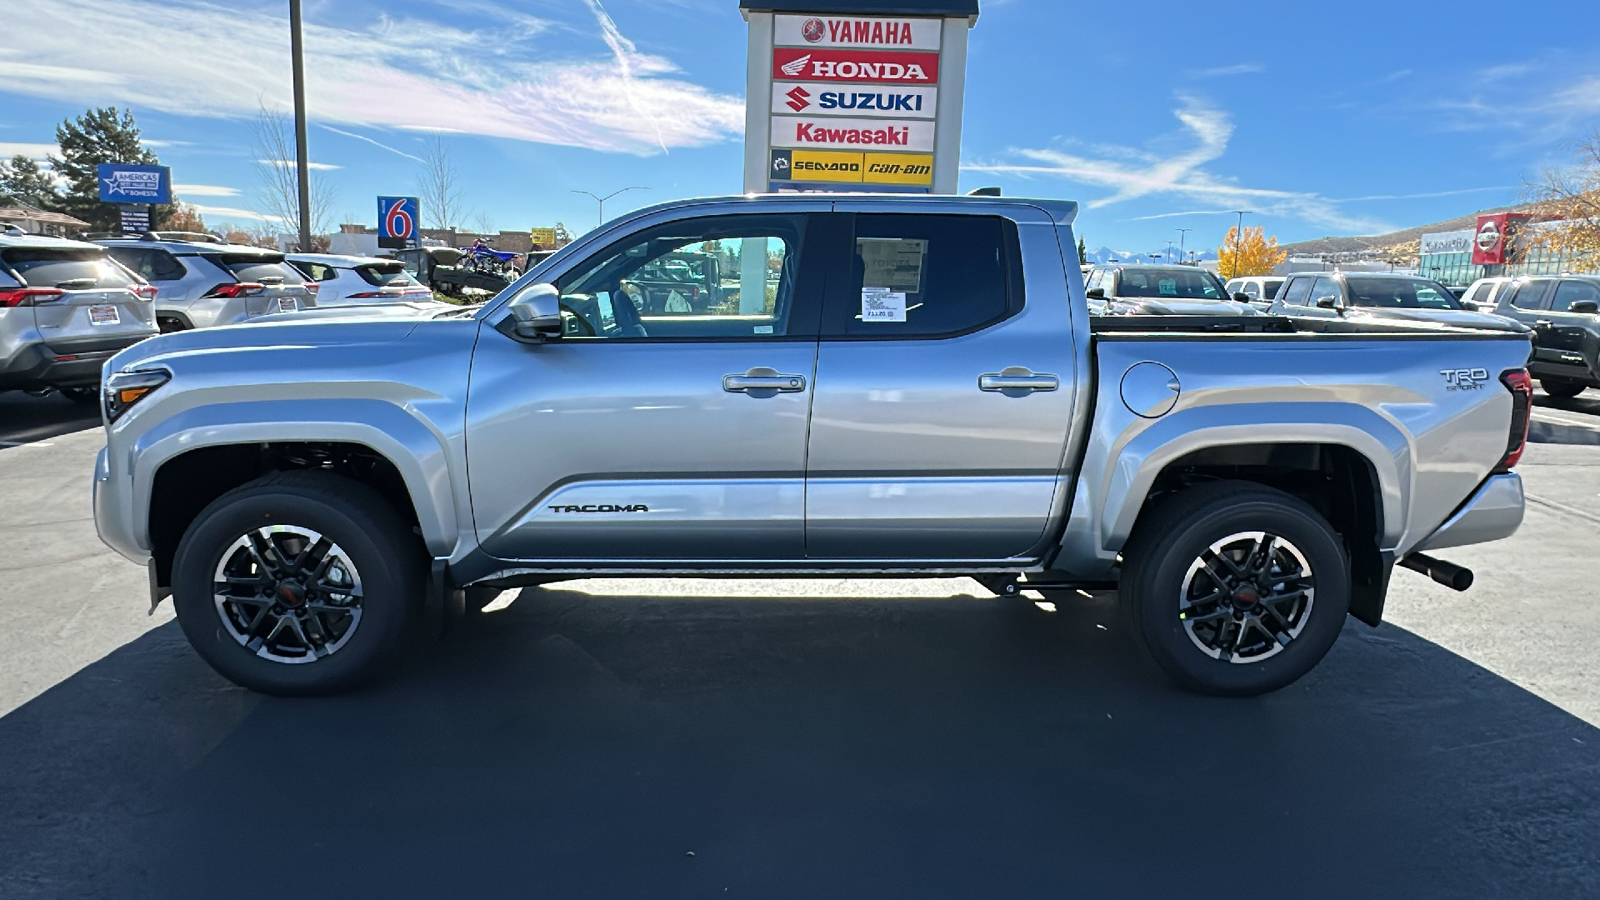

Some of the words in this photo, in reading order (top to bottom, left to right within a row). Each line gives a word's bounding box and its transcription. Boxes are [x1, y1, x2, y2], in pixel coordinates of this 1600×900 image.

[828, 20, 912, 44] YAMAHA
[811, 61, 928, 79] HONDA
[819, 92, 922, 111] SUZUKI
[796, 123, 909, 145] Kawasaki
[868, 163, 931, 175] can-am
[386, 198, 413, 239] 6
[1440, 368, 1489, 385] TRD
[1446, 384, 1485, 392] SPORT
[548, 505, 648, 513] TACOMA
